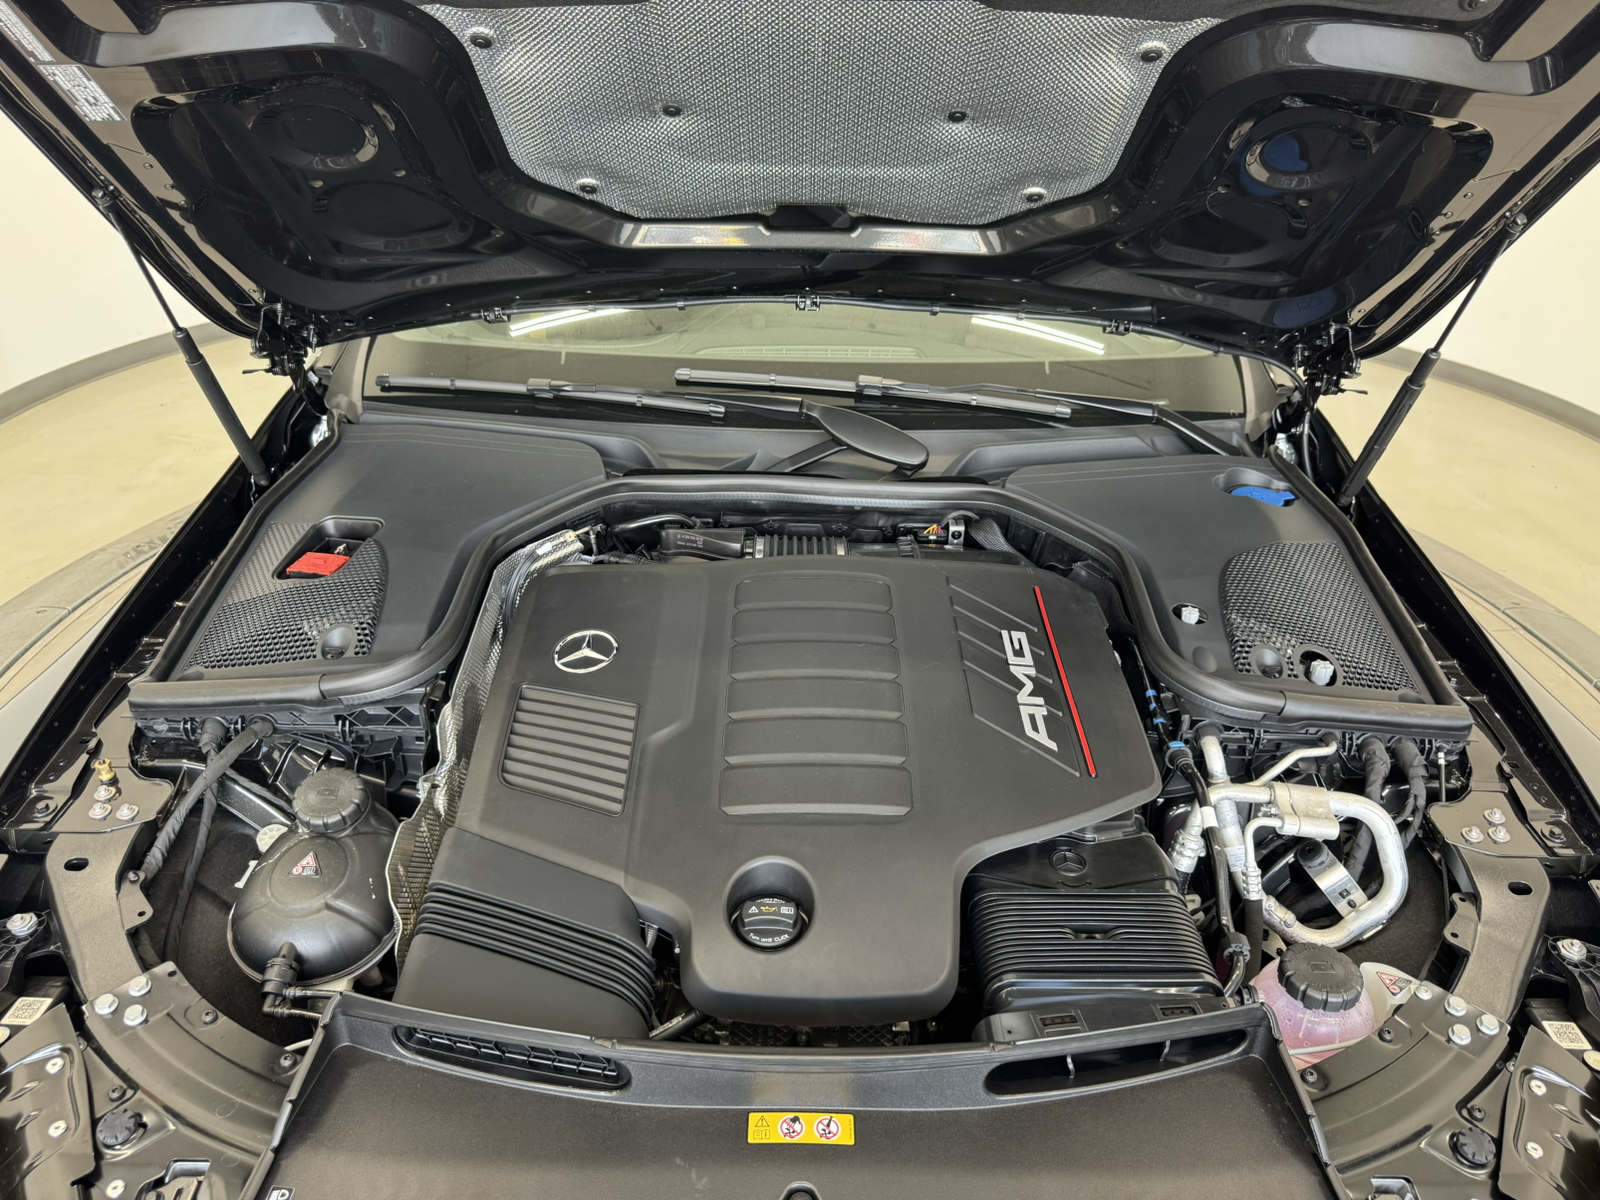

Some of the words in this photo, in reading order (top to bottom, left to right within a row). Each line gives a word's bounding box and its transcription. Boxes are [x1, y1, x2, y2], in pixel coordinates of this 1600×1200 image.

[1001, 630, 1058, 752] AMG
[749, 932, 760, 940] Turn
[774, 934, 789, 942] CLICK
